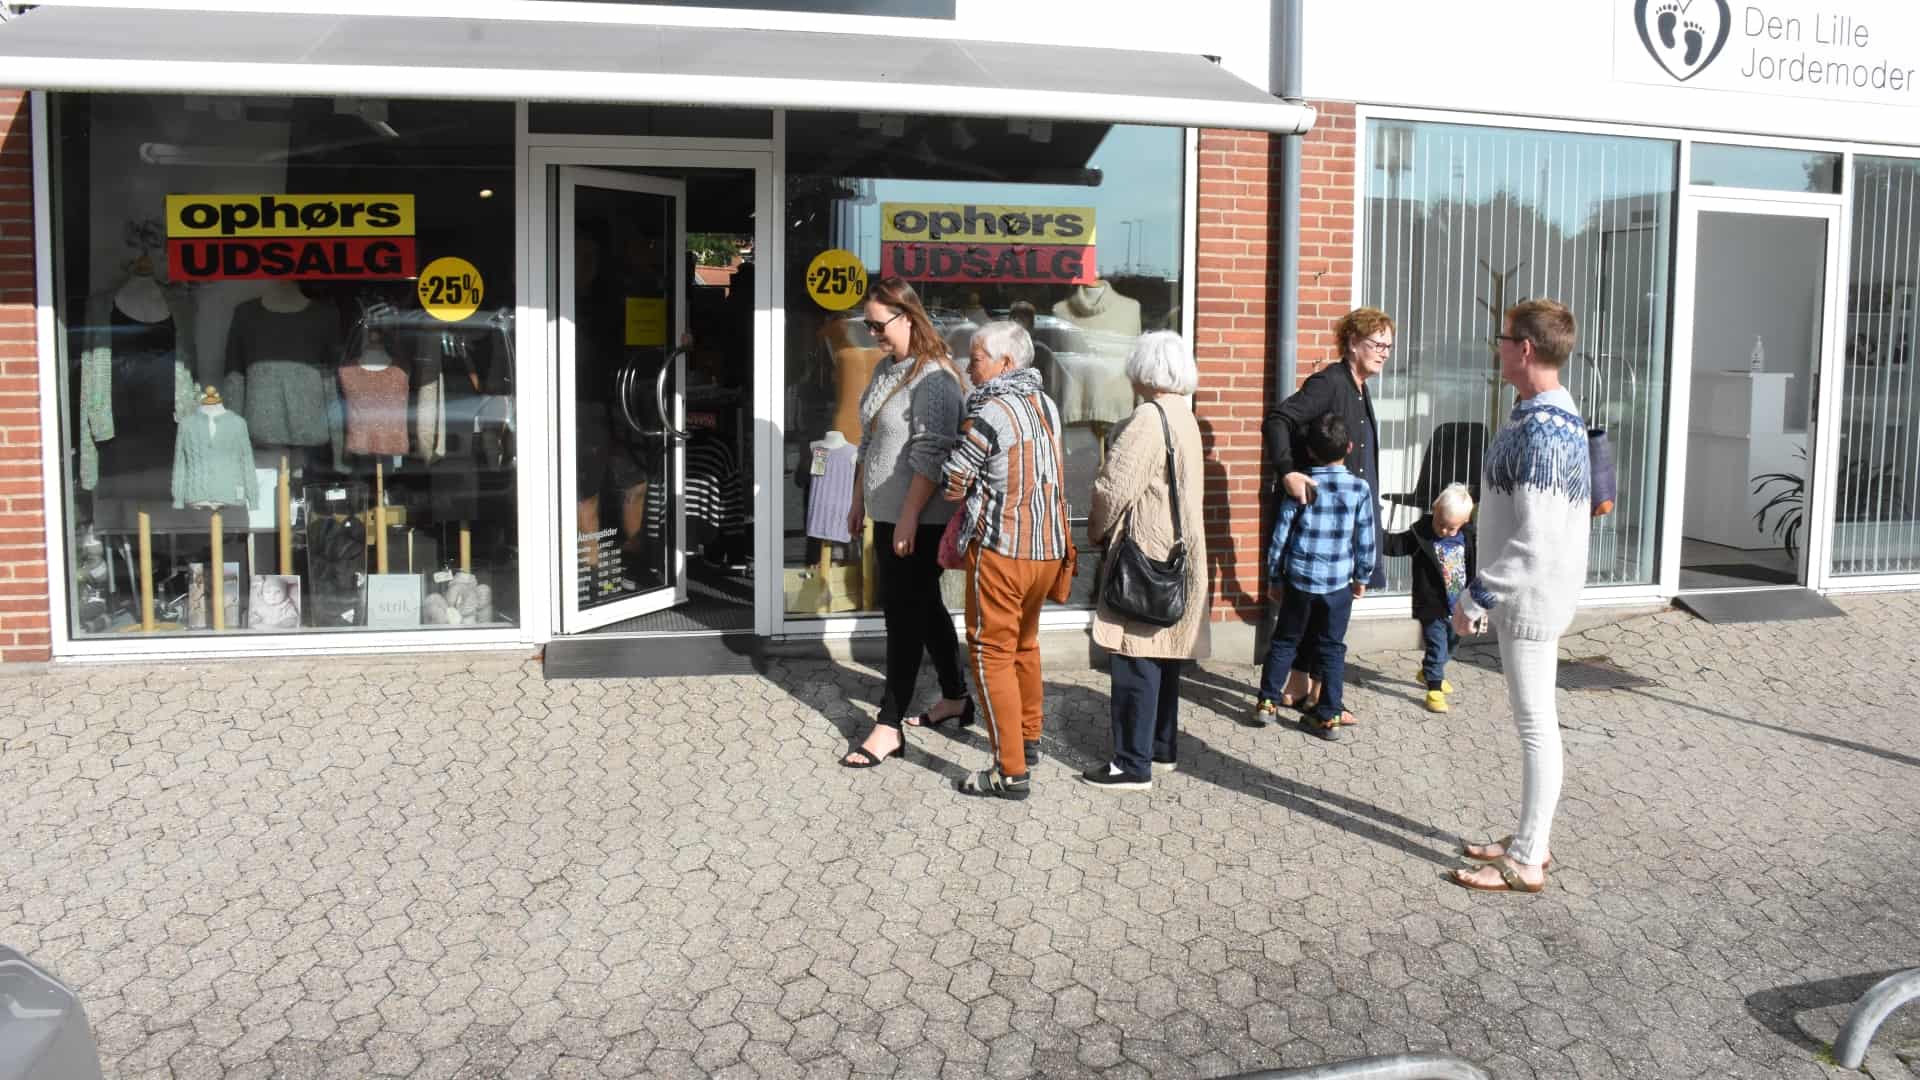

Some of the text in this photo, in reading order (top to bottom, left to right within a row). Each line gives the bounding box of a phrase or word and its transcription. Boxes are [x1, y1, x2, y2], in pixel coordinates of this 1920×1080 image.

[1745, 6, 1869, 47] Den Lille
[1741, 48, 1915, 91] Jordemoder
[180, 197, 401, 234] ophørs
[893, 205, 1084, 240] ophørs
[181, 242, 401, 276] UDSALG
[892, 246, 1084, 280] UDSALG
